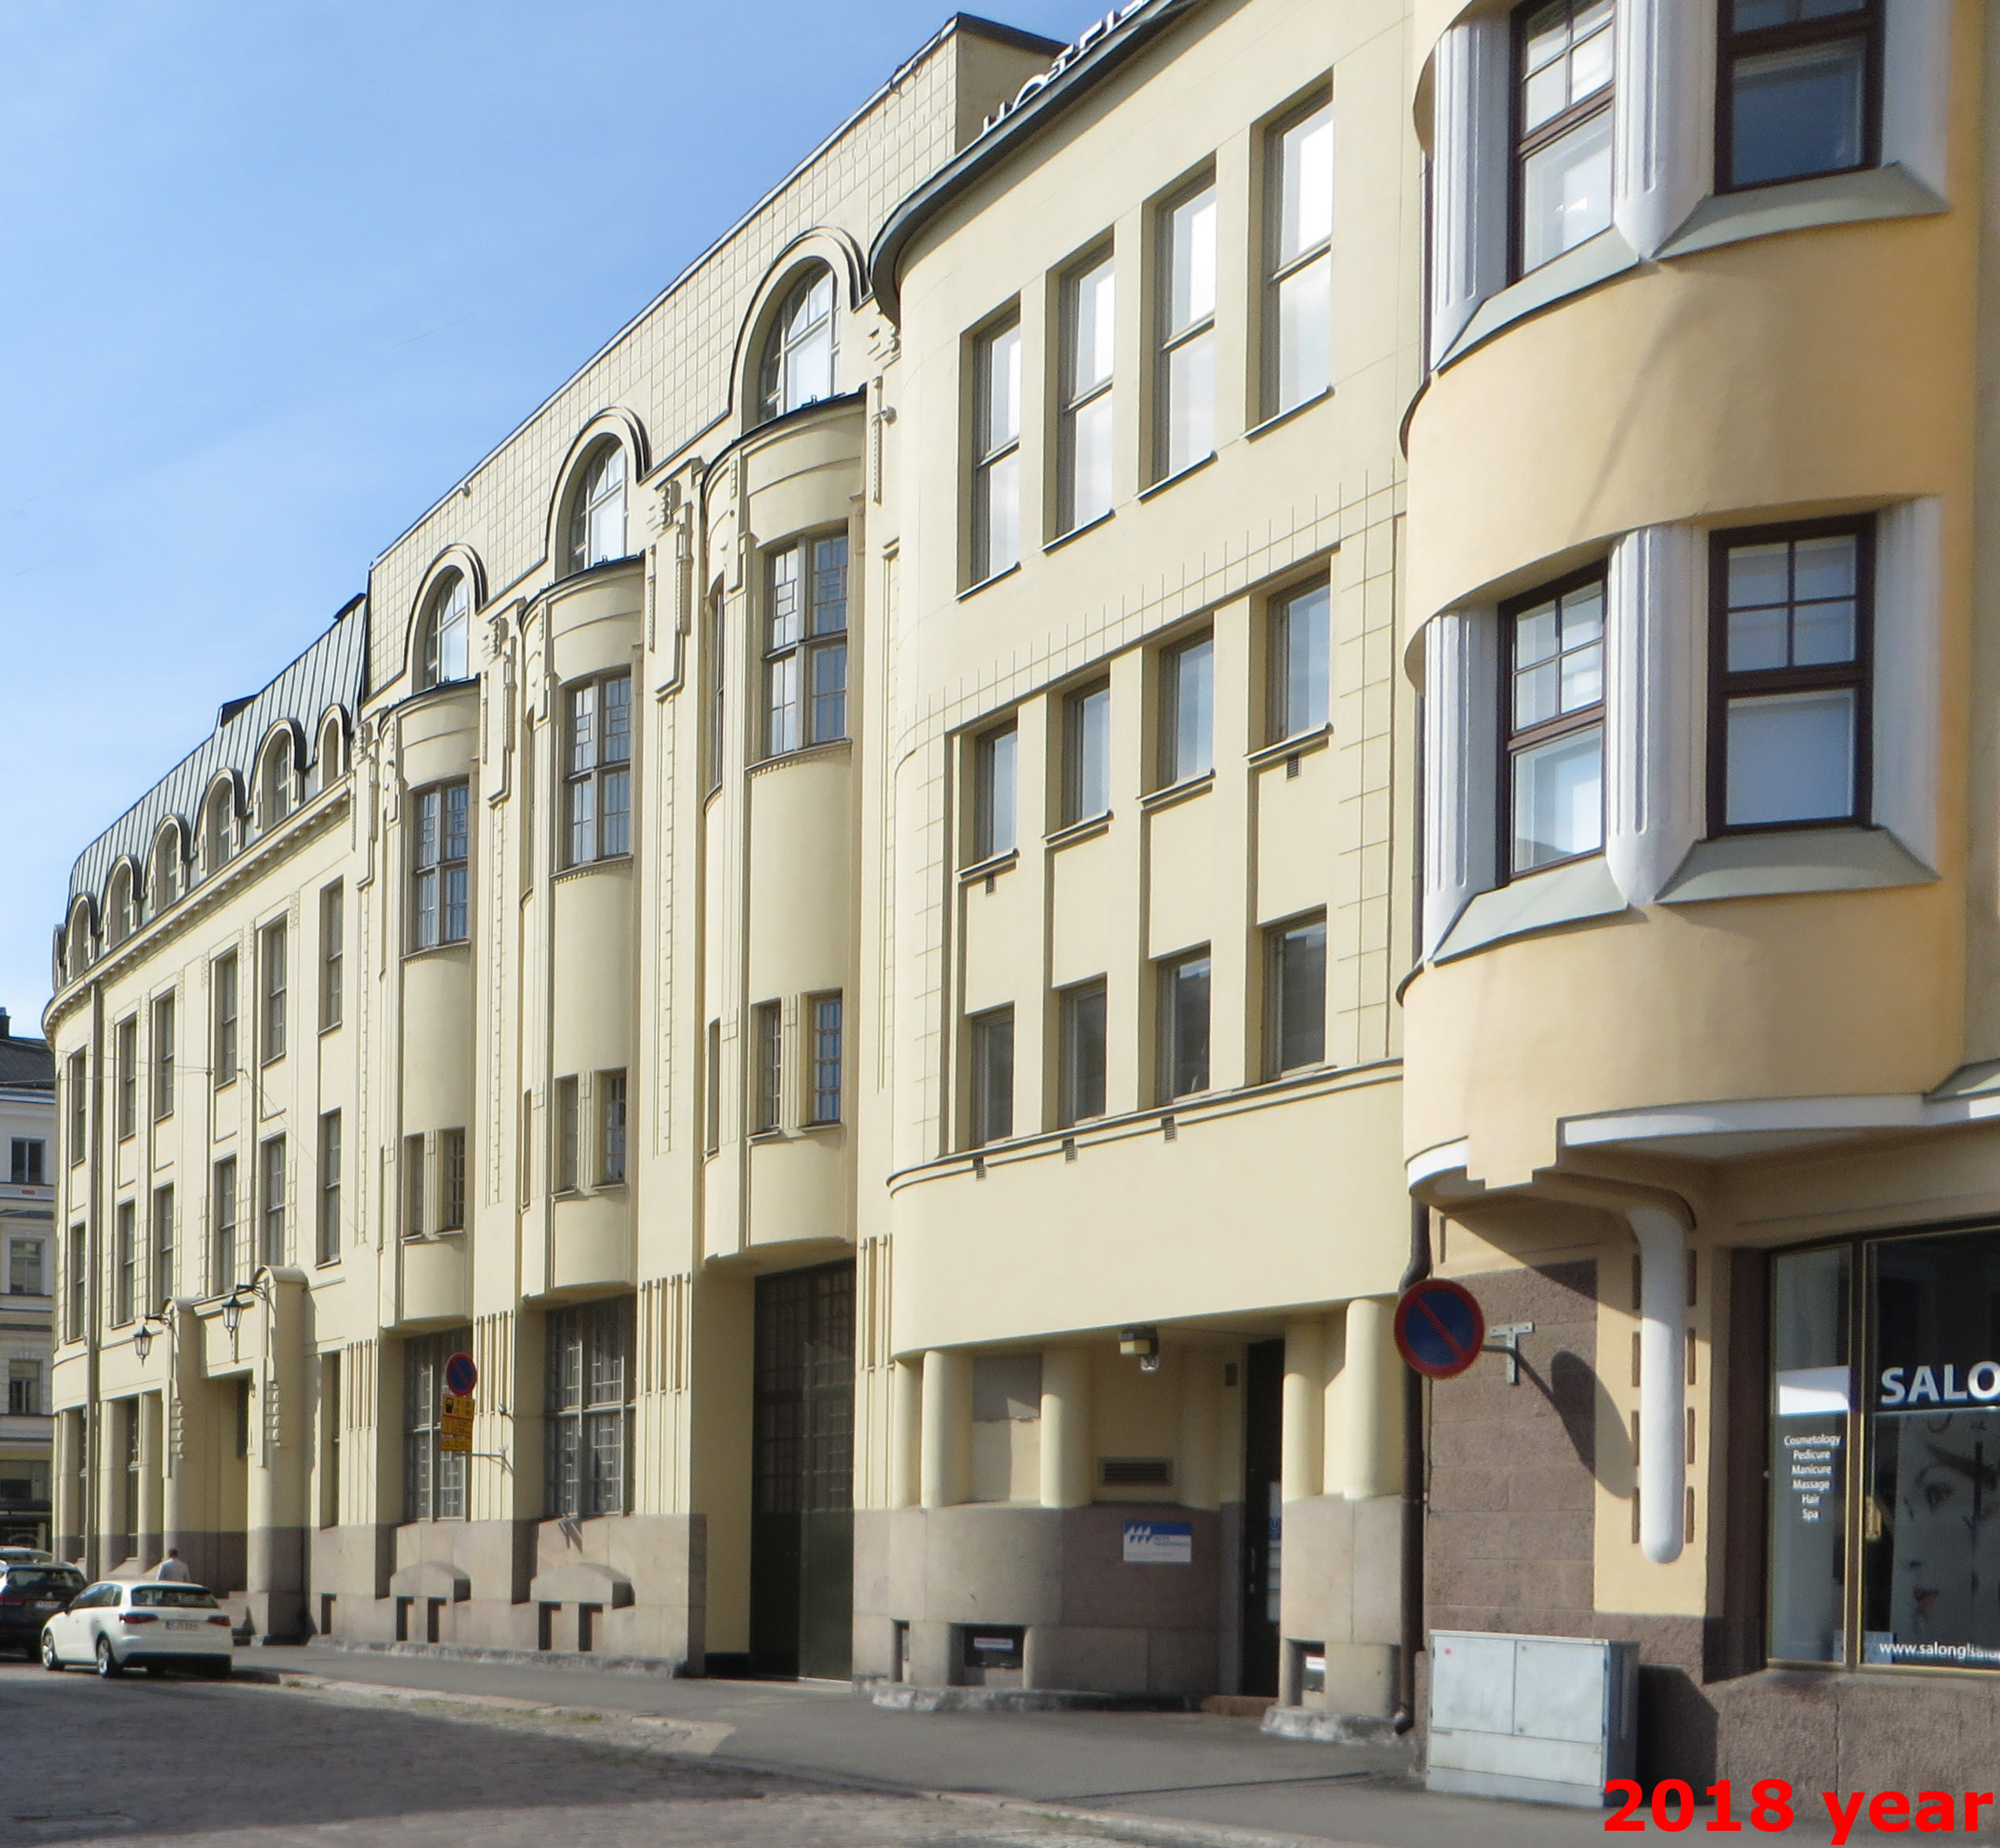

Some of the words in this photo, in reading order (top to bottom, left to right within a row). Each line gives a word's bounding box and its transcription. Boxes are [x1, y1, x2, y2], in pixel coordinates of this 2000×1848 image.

[1881, 1361, 2000, 1404] SALO
[1784, 1434, 1841, 1447] Cosmetology
[1793, 1449, 1831, 1461] Pedicure
[1791, 1464, 1831, 1475] Manicure
[1792, 1479, 1830, 1492] Massage
[1802, 1493, 1820, 1504] Hair
[1802, 1508, 1818, 1521] Spa
